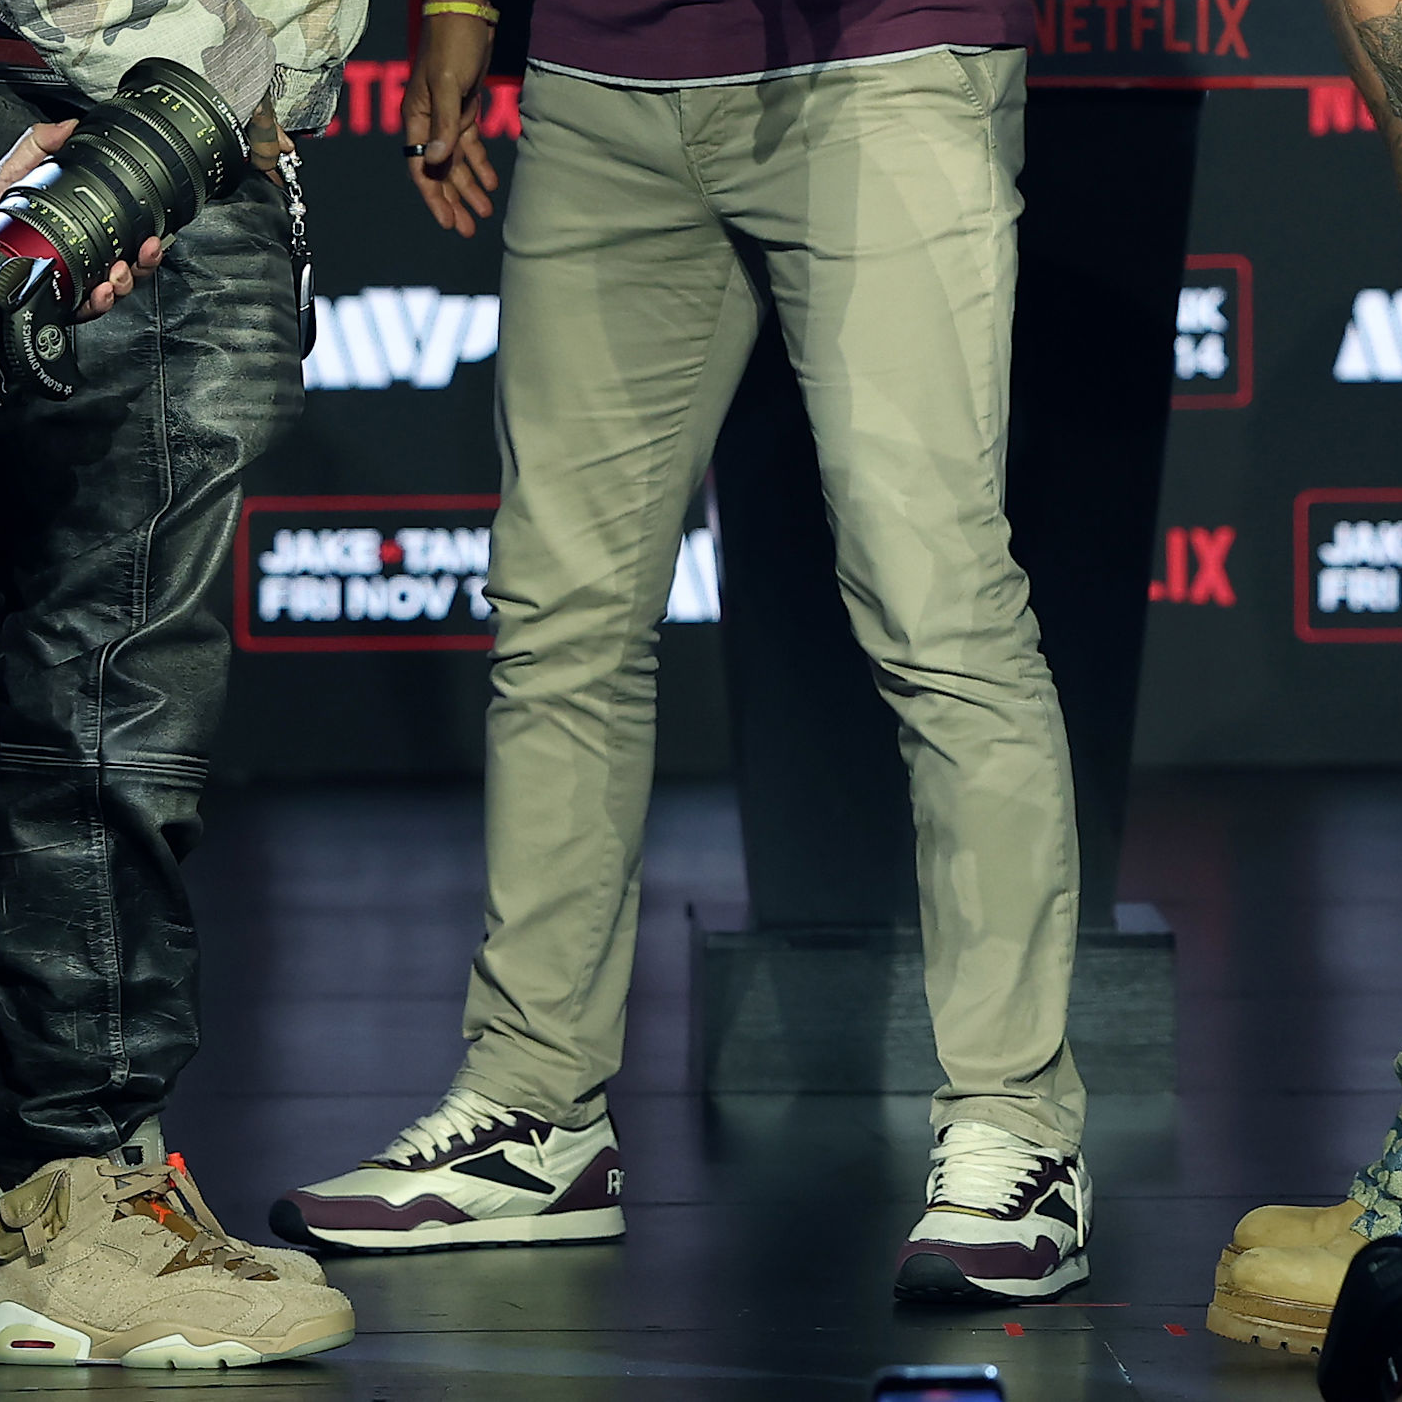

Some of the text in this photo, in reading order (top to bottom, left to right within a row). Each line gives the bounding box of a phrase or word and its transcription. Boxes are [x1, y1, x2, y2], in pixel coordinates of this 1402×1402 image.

[22, 324, 64, 392] GLOBAL DYNAMICS
[260, 528, 490, 574] JAKE TAN
[260, 574, 342, 619] FRI
[346, 574, 456, 619] NOV
[1319, 566, 1400, 610] FRI
